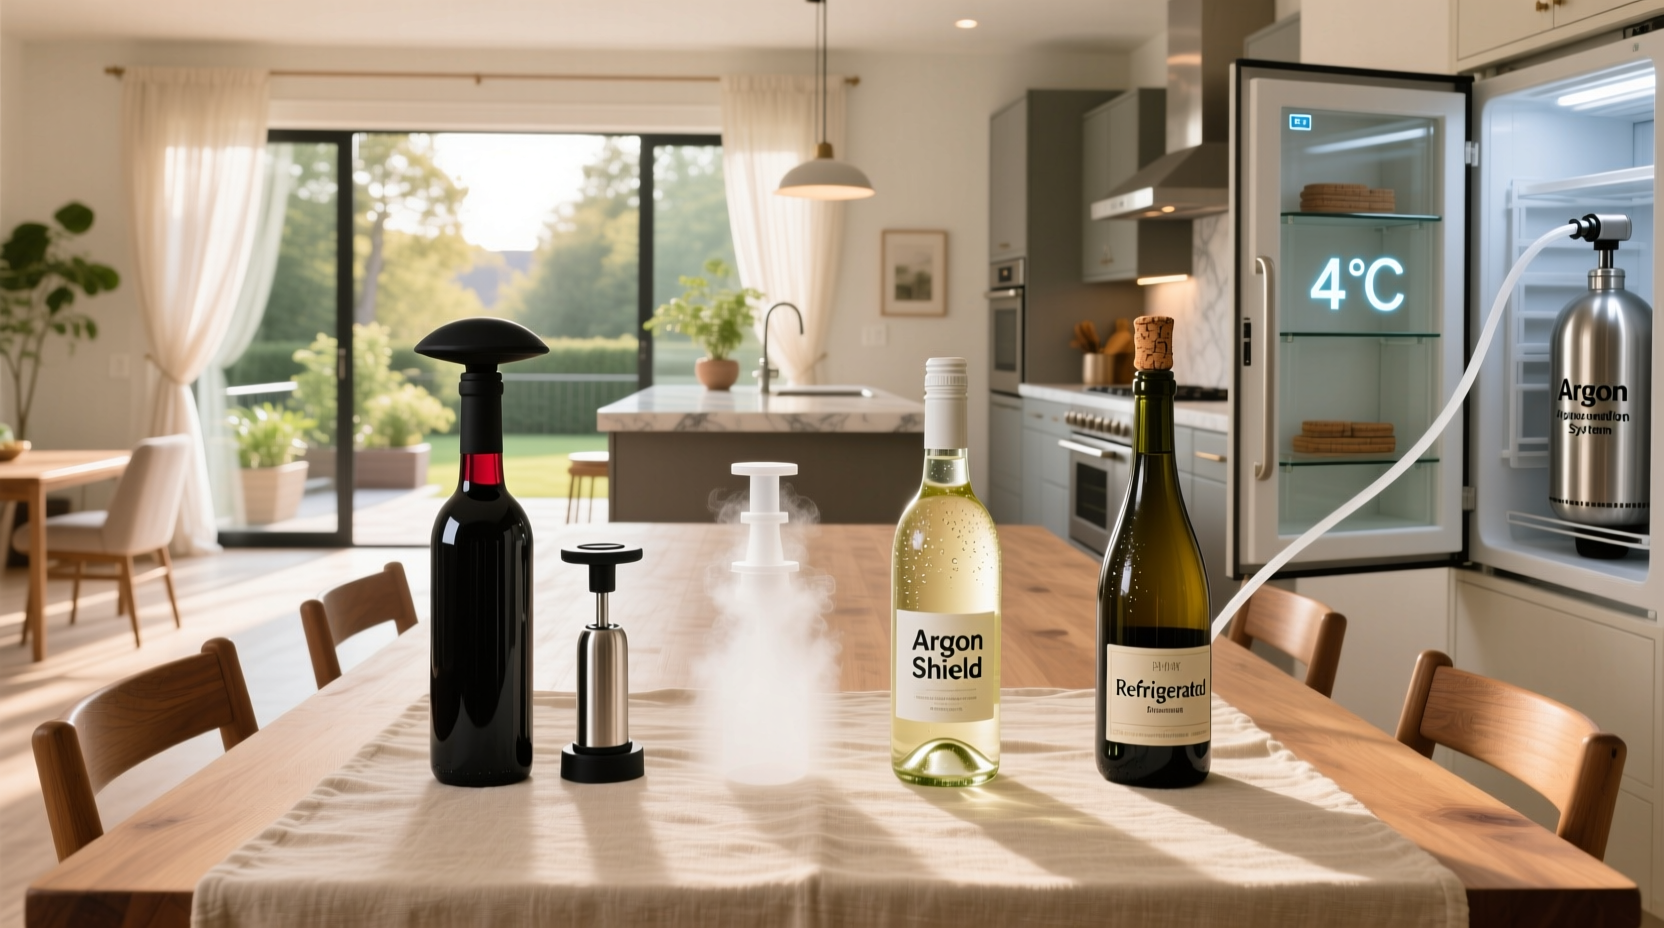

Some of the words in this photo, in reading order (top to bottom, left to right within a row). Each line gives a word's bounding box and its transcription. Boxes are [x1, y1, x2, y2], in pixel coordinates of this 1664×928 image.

[1310, 257, 1405, 311] 4°C
[1558, 377, 1628, 407] Argon
[912, 629, 983, 658] Argon
[912, 656, 982, 680] Shield
